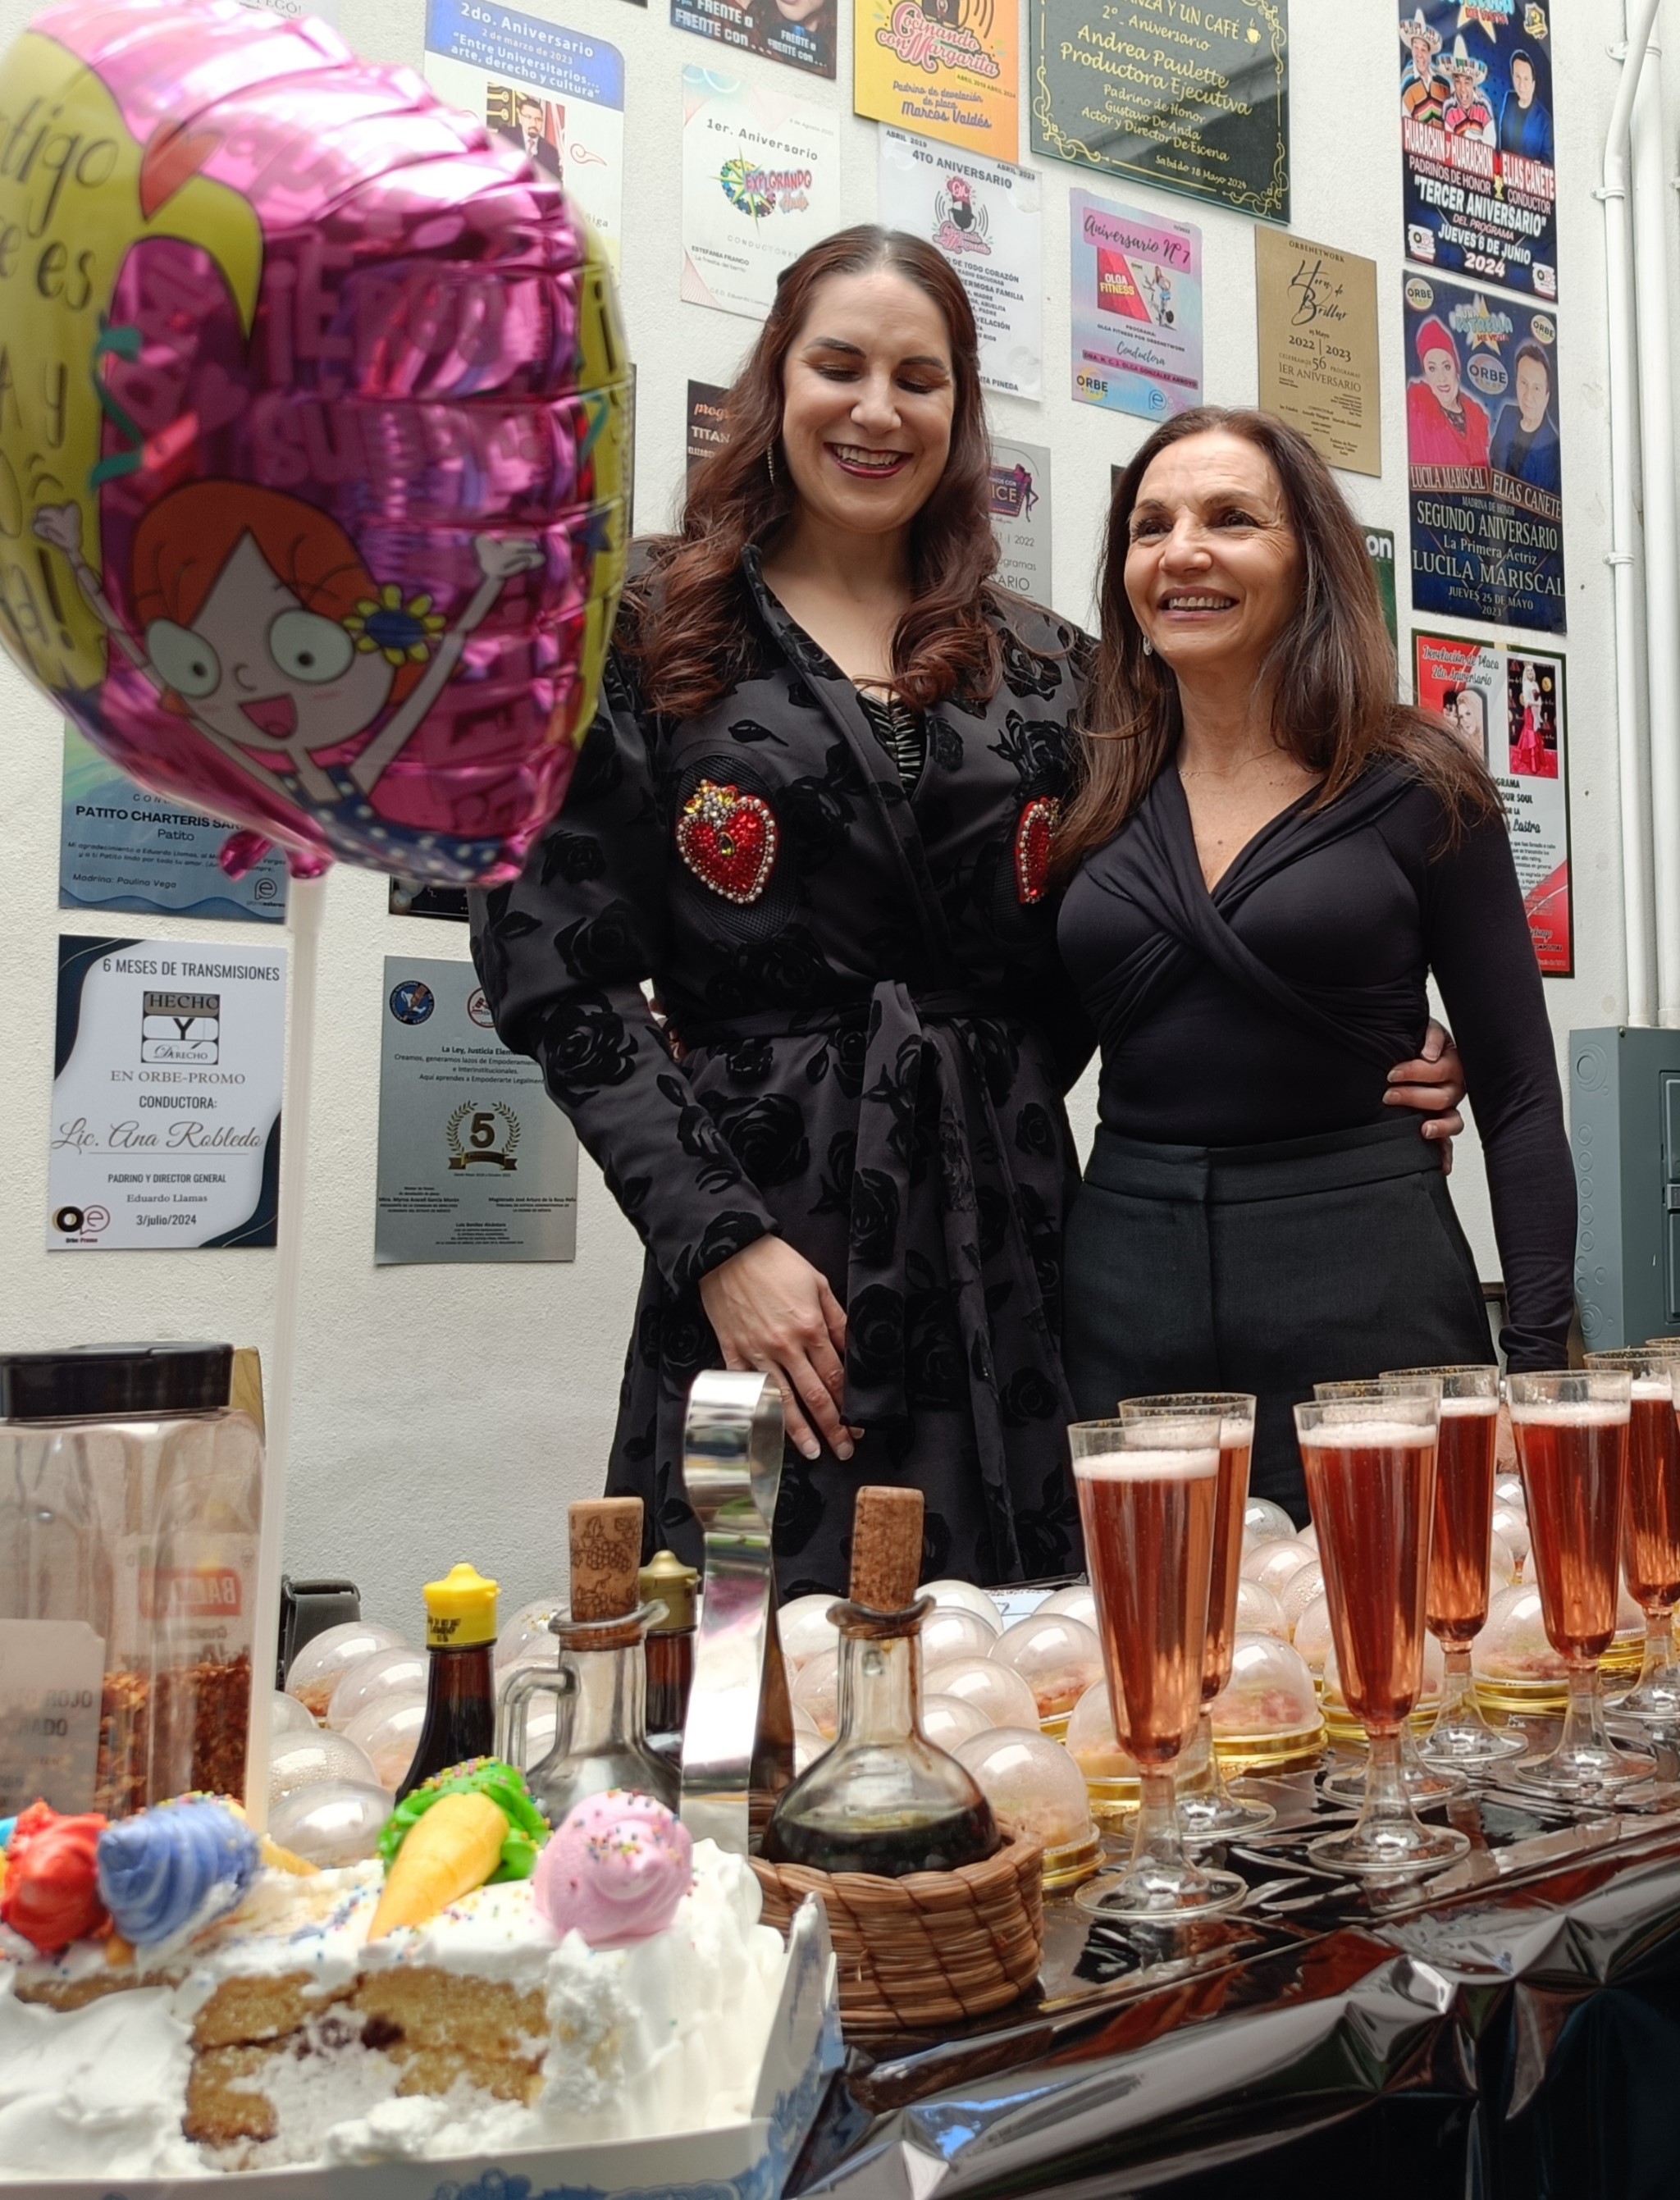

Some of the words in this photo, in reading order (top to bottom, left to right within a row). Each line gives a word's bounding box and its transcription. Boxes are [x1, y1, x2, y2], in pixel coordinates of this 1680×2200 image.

[675, 8, 722, 36] FRENTE
[697, 0, 742, 23] FRENTE
[1168, 0, 1176, 16] Y
[1180, 4, 1201, 25] UN
[1205, 14, 1239, 39] CAFÉ
[460, 2, 496, 25] 2do.
[501, 16, 594, 57] Aniversario
[893, 2, 979, 50] Cocinando
[1128, 15, 1211, 52] Aniversario
[482, 29, 487, 37] 2
[490, 30, 501, 41] de
[504, 35, 533, 52] marzo
[536, 46, 547, 56] de
[550, 49, 573, 65] 2023
[1078, 25, 1151, 61] Andrea
[1153, 49, 1229, 89] Paulette
[451, 44, 482, 63] arte,
[485, 54, 536, 80] derecho
[541, 72, 546, 84] y
[893, 80, 925, 94] Padrino
[957, 74, 972, 84] ABRIL
[987, 84, 1002, 95] ABRIL
[1060, 42, 1167, 89] Productora
[1171, 77, 1253, 116] Ejecutiva
[902, 101, 949, 121] Marcos
[953, 109, 992, 128] Valdés
[1103, 84, 1152, 106] Padrino
[1154, 99, 1168, 111] de
[1171, 103, 1206, 124] Honor
[1105, 102, 1152, 123] Gustavo
[1153, 116, 1168, 129] De
[1169, 121, 1202, 141] Anda
[707, 118, 733, 135] 1er.
[738, 128, 818, 161] Aniversario
[887, 130, 906, 142] ABRIL
[1082, 107, 1114, 123] Actor
[1125, 120, 1171, 144] Director
[1174, 135, 1189, 150] De
[1191, 141, 1230, 162] Escena
[1404, 117, 1445, 162] HUARACHIN
[912, 149, 934, 165] 4TO
[936, 157, 1012, 189] ANIVERSARIO
[997, 163, 1016, 175] ABRIL
[1203, 170, 1226, 184] Mayo
[1503, 153, 1523, 187] ELIAS
[1525, 162, 1554, 199] CAÑETE
[746, 170, 812, 192] EXPLORANDO
[1409, 156, 1449, 181] PADRINOS
[1451, 169, 1461, 185] DE
[1463, 173, 1491, 195] HONOR
[1508, 189, 1550, 215] CONDUCTOR
[1084, 215, 1159, 252] Aniversario
[1453, 213, 1468, 226] DEL
[1470, 219, 1513, 240] PROGRAMA
[1289, 240, 1345, 262] ORBENETWORK
[1438, 224, 1476, 247] JUEVES
[1478, 238, 1484, 250] 6
[1486, 240, 1500, 255] DE
[1502, 242, 1531, 264] JUNIO
[964, 262, 983, 272] TODO
[1464, 252, 1505, 277] 2024
[961, 280, 994, 293] ERMOSA
[996, 287, 1024, 301] FAMILIA
[1100, 282, 1134, 295] FITNESS
[1105, 273, 1127, 285] OLGA
[1408, 288, 1431, 299] ORBE
[1533, 321, 1554, 337] ORBE
[1117, 341, 1165, 366] Conductora
[1289, 335, 1315, 349] 2022
[1326, 345, 1351, 362] 2023
[1312, 356, 1326, 371] 56
[1470, 365, 1506, 383] ORBE
[993, 377, 1019, 391] PINEDA
[1076, 376, 1108, 392] ORBE
[1297, 369, 1361, 392] ANIVERSARIO
[992, 485, 1017, 502] ICE
[1411, 466, 1440, 487] LUCILA
[1443, 468, 1486, 490] MARISCAL
[1493, 474, 1522, 502] ELIAS
[1524, 487, 1561, 519] CAÑETE
[1418, 500, 1475, 534] SEGUNDO
[1479, 514, 1557, 550] ANIVERSARIO
[1015, 536, 1034, 546] 2022
[1444, 535, 1456, 549] La
[1461, 538, 1502, 558] Primera
[1507, 549, 1537, 566] Actriz
[1413, 550, 1475, 581] LUCILA
[1481, 564, 1566, 597] MARISCAL
[1449, 586, 1480, 600] JUEVES
[1482, 593, 1492, 602] 25
[1495, 593, 1505, 605] DE
[1509, 597, 1533, 609] MAYO
[1496, 778, 1520, 788] GRAMA
[1517, 793, 1533, 803] SOUL
[75, 806, 129, 819] PATITO
[131, 810, 210, 828] CHARTERIS
[158, 828, 194, 842] Patito
[73, 874, 114, 883] Madrina:
[116, 878, 151, 886] Paulina
[153, 880, 176, 888] Vega
[103, 958, 111, 971] 6
[116, 959, 158, 974] MESES
[162, 961, 177, 975] DE
[181, 963, 280, 981] TRANSMISIONES
[149, 994, 220, 1010] HECHO
[172, 1017, 195, 1041] Y
[452, 1047, 466, 1055] Ley,
[111, 1070, 134, 1082] EN
[139, 1071, 245, 1084] ORBE-PROMO
[139, 1095, 217, 1109] CONDUCTORA:
[52, 1118, 99, 1155] Lic.
[108, 1121, 159, 1148] Ana
[166, 1121, 262, 1148] Robledo
[469, 1112, 495, 1148] 5
[107, 1174, 144, 1183] PADRINO
[146, 1174, 151, 1183] Y
[153, 1174, 191, 1183] DIRECTOR
[193, 1174, 226, 1183] GENERAL
[126, 1194, 170, 1203] Eduardo
[173, 1194, 208, 1203] Llamas
[136, 1214, 196, 1226] 3/julio/2024
